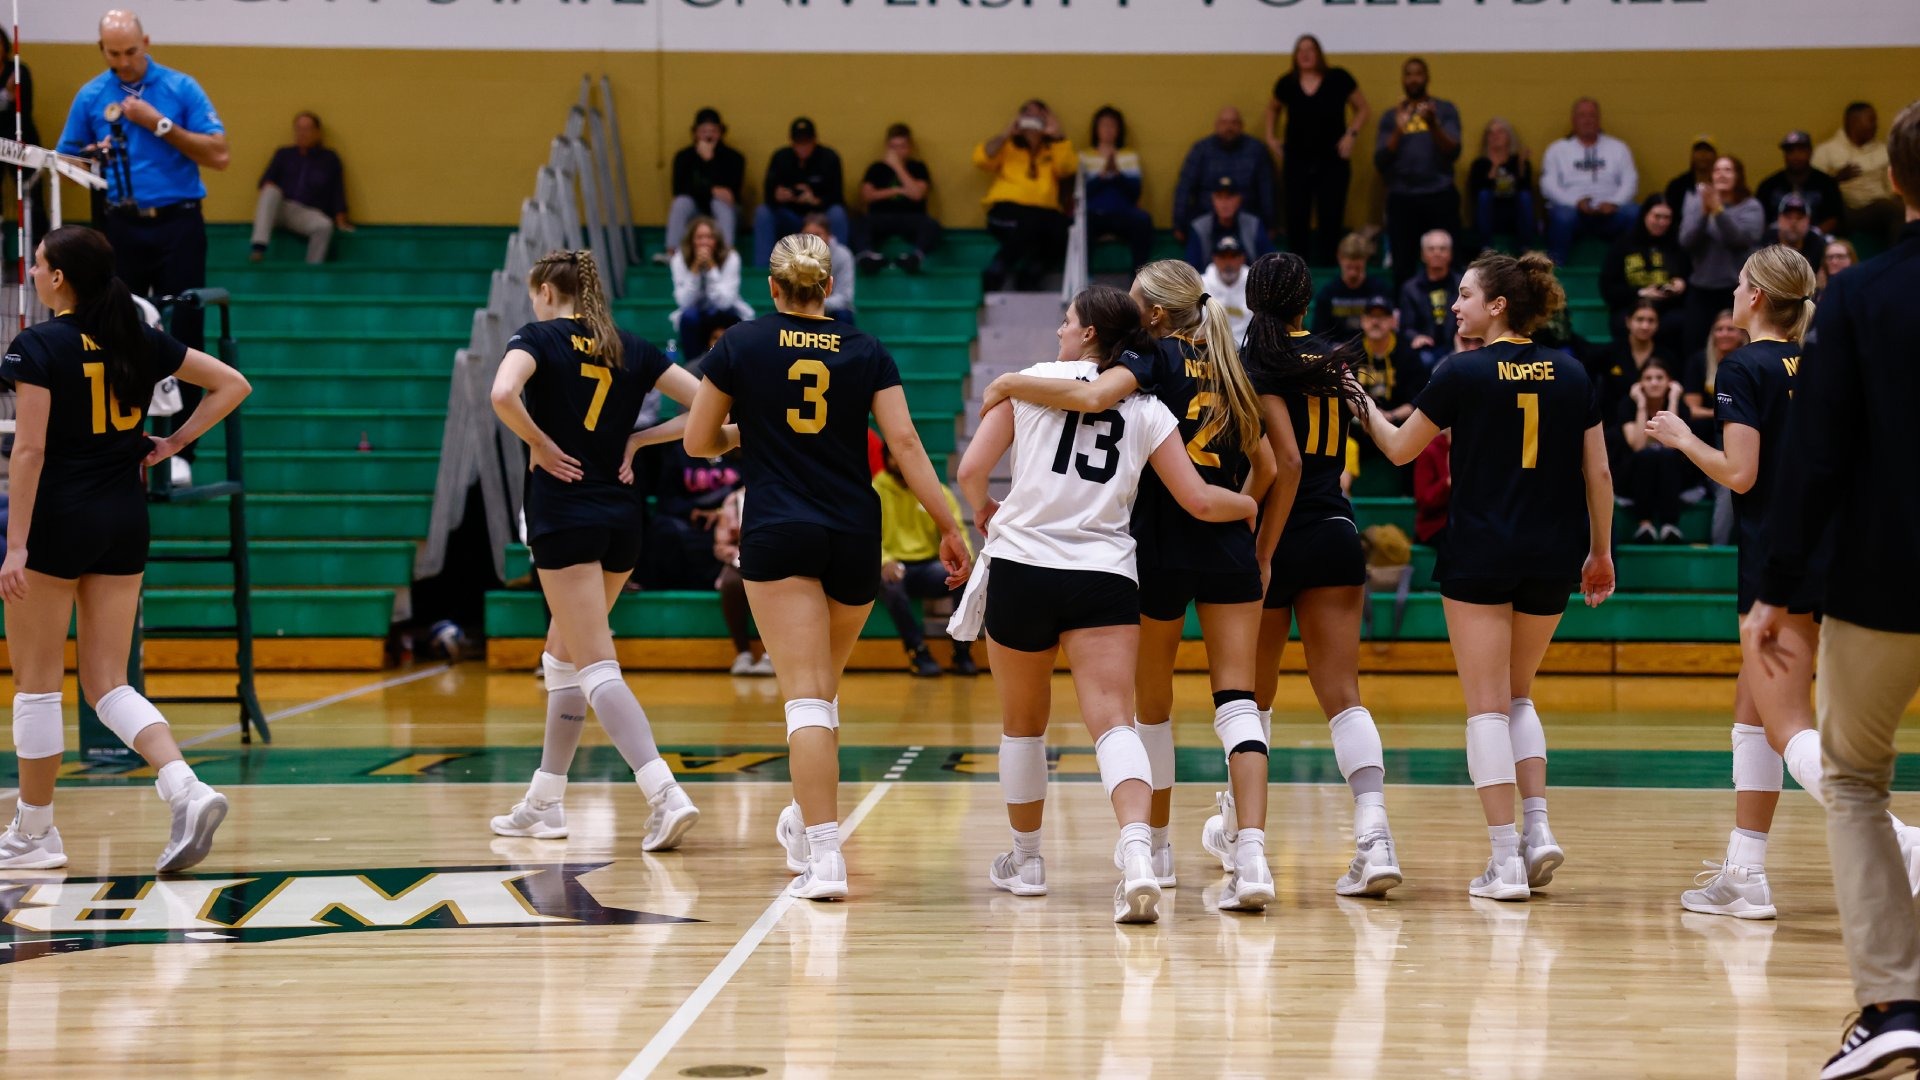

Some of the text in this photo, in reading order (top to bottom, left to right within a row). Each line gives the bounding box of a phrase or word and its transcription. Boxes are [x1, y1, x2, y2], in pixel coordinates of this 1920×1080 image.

[779, 329, 841, 353] NORSE
[1497, 361, 1555, 380] NORSE
[580, 362, 613, 432] 7
[786, 359, 831, 434] 3
[1186, 391, 1228, 469] 2
[1517, 393, 1539, 469] 1
[1051, 408, 1126, 485] 13
